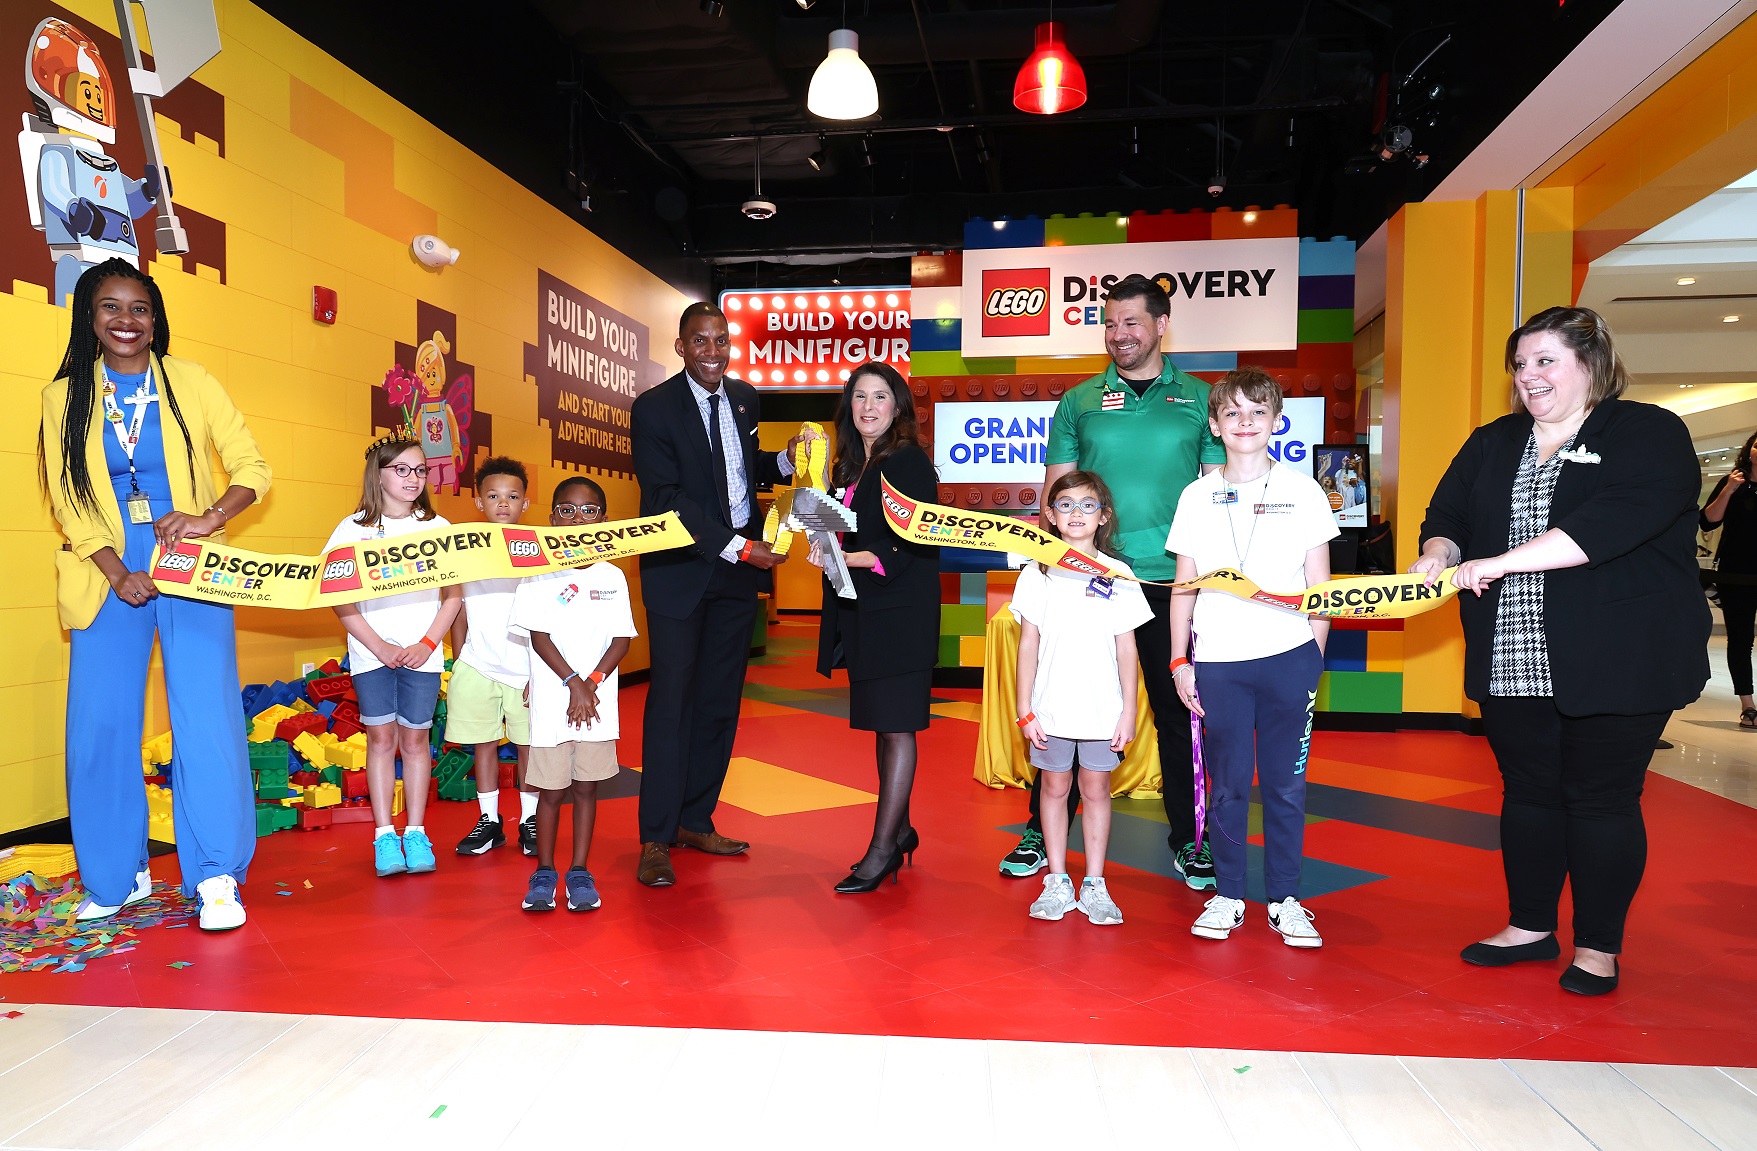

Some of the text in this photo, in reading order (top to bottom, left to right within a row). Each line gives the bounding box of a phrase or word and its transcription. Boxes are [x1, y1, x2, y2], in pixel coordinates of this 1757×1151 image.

[986, 288, 1047, 318] LEGO
[547, 289, 639, 361] BUILD YOUR
[767, 310, 911, 332] BUILD YOUR
[749, 337, 911, 365] MINIFIGUR
[547, 334, 637, 398] MINIFIGURE
[557, 389, 580, 415] AND
[582, 397, 610, 423] START
[557, 419, 632, 456] ADVENTURE HER
[964, 417, 1054, 439] GRAN
[882, 490, 912, 520] LEGO
[914, 533, 977, 547] WASHINGTON,
[917, 524, 985, 539] CENTER
[509, 540, 541, 557] LEGO
[552, 543, 617, 560] CENTER
[158, 553, 198, 571] LEGO
[368, 558, 438, 581] CENTER
[559, 552, 620, 567] WASHINGTON,
[1063, 556, 1105, 575] LEGO
[201, 570, 264, 590] CENTER
[322, 560, 356, 581] LEGO
[372, 571, 458, 592] WASHINGTON, D.C.
[196, 585, 272, 601] WASHINGTON, D.C.
[1309, 606, 1376, 616] ENTER
[1293, 711, 1314, 775] Hurley
